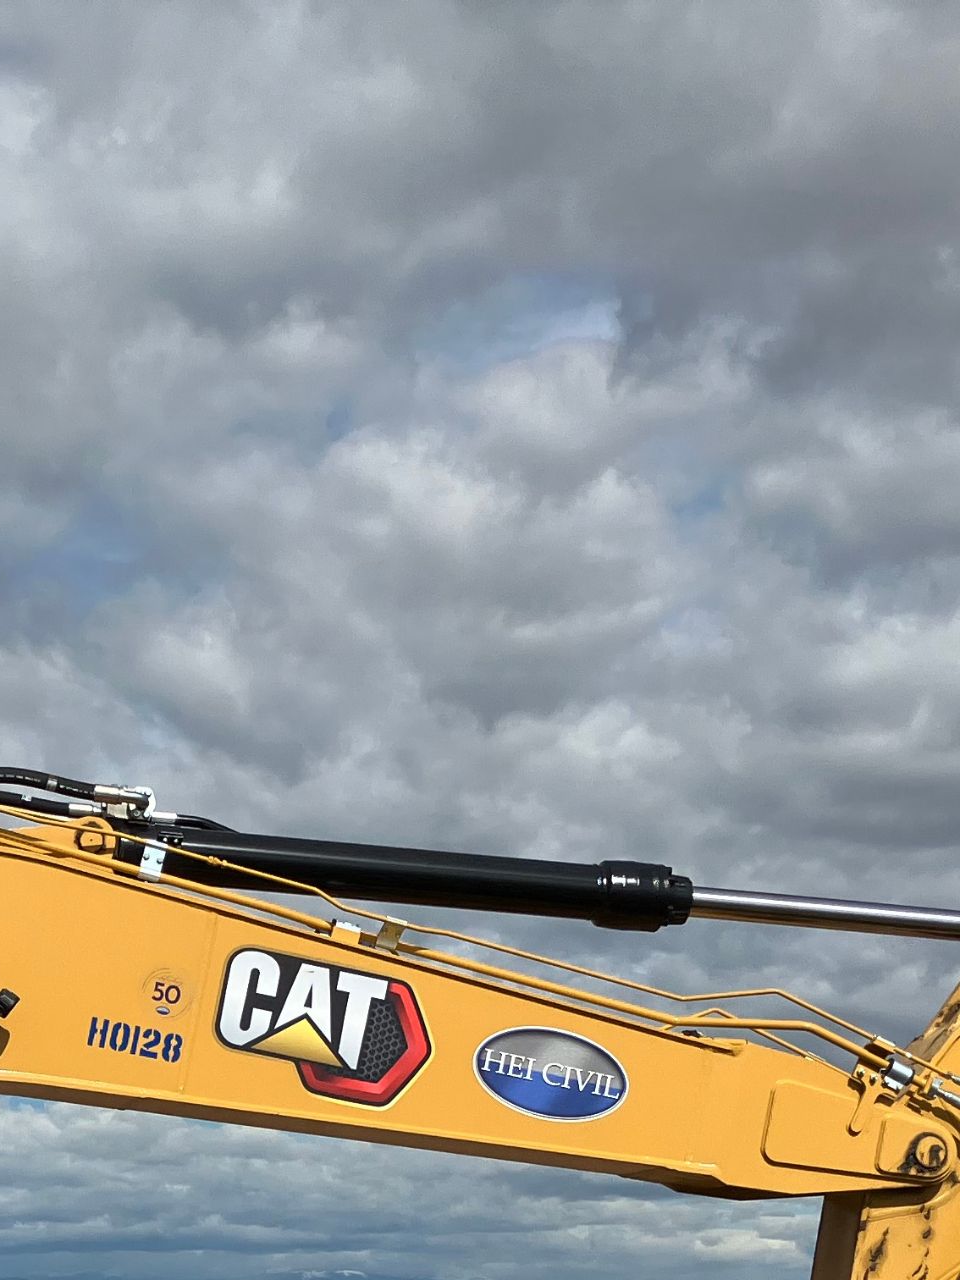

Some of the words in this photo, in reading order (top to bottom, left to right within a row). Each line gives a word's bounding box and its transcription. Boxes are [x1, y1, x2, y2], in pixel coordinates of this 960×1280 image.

[151, 981, 181, 1004] 50
[220, 950, 389, 1071] CAT
[481, 1048, 537, 1081] HEI
[542, 1062, 620, 1099] CIVIL
